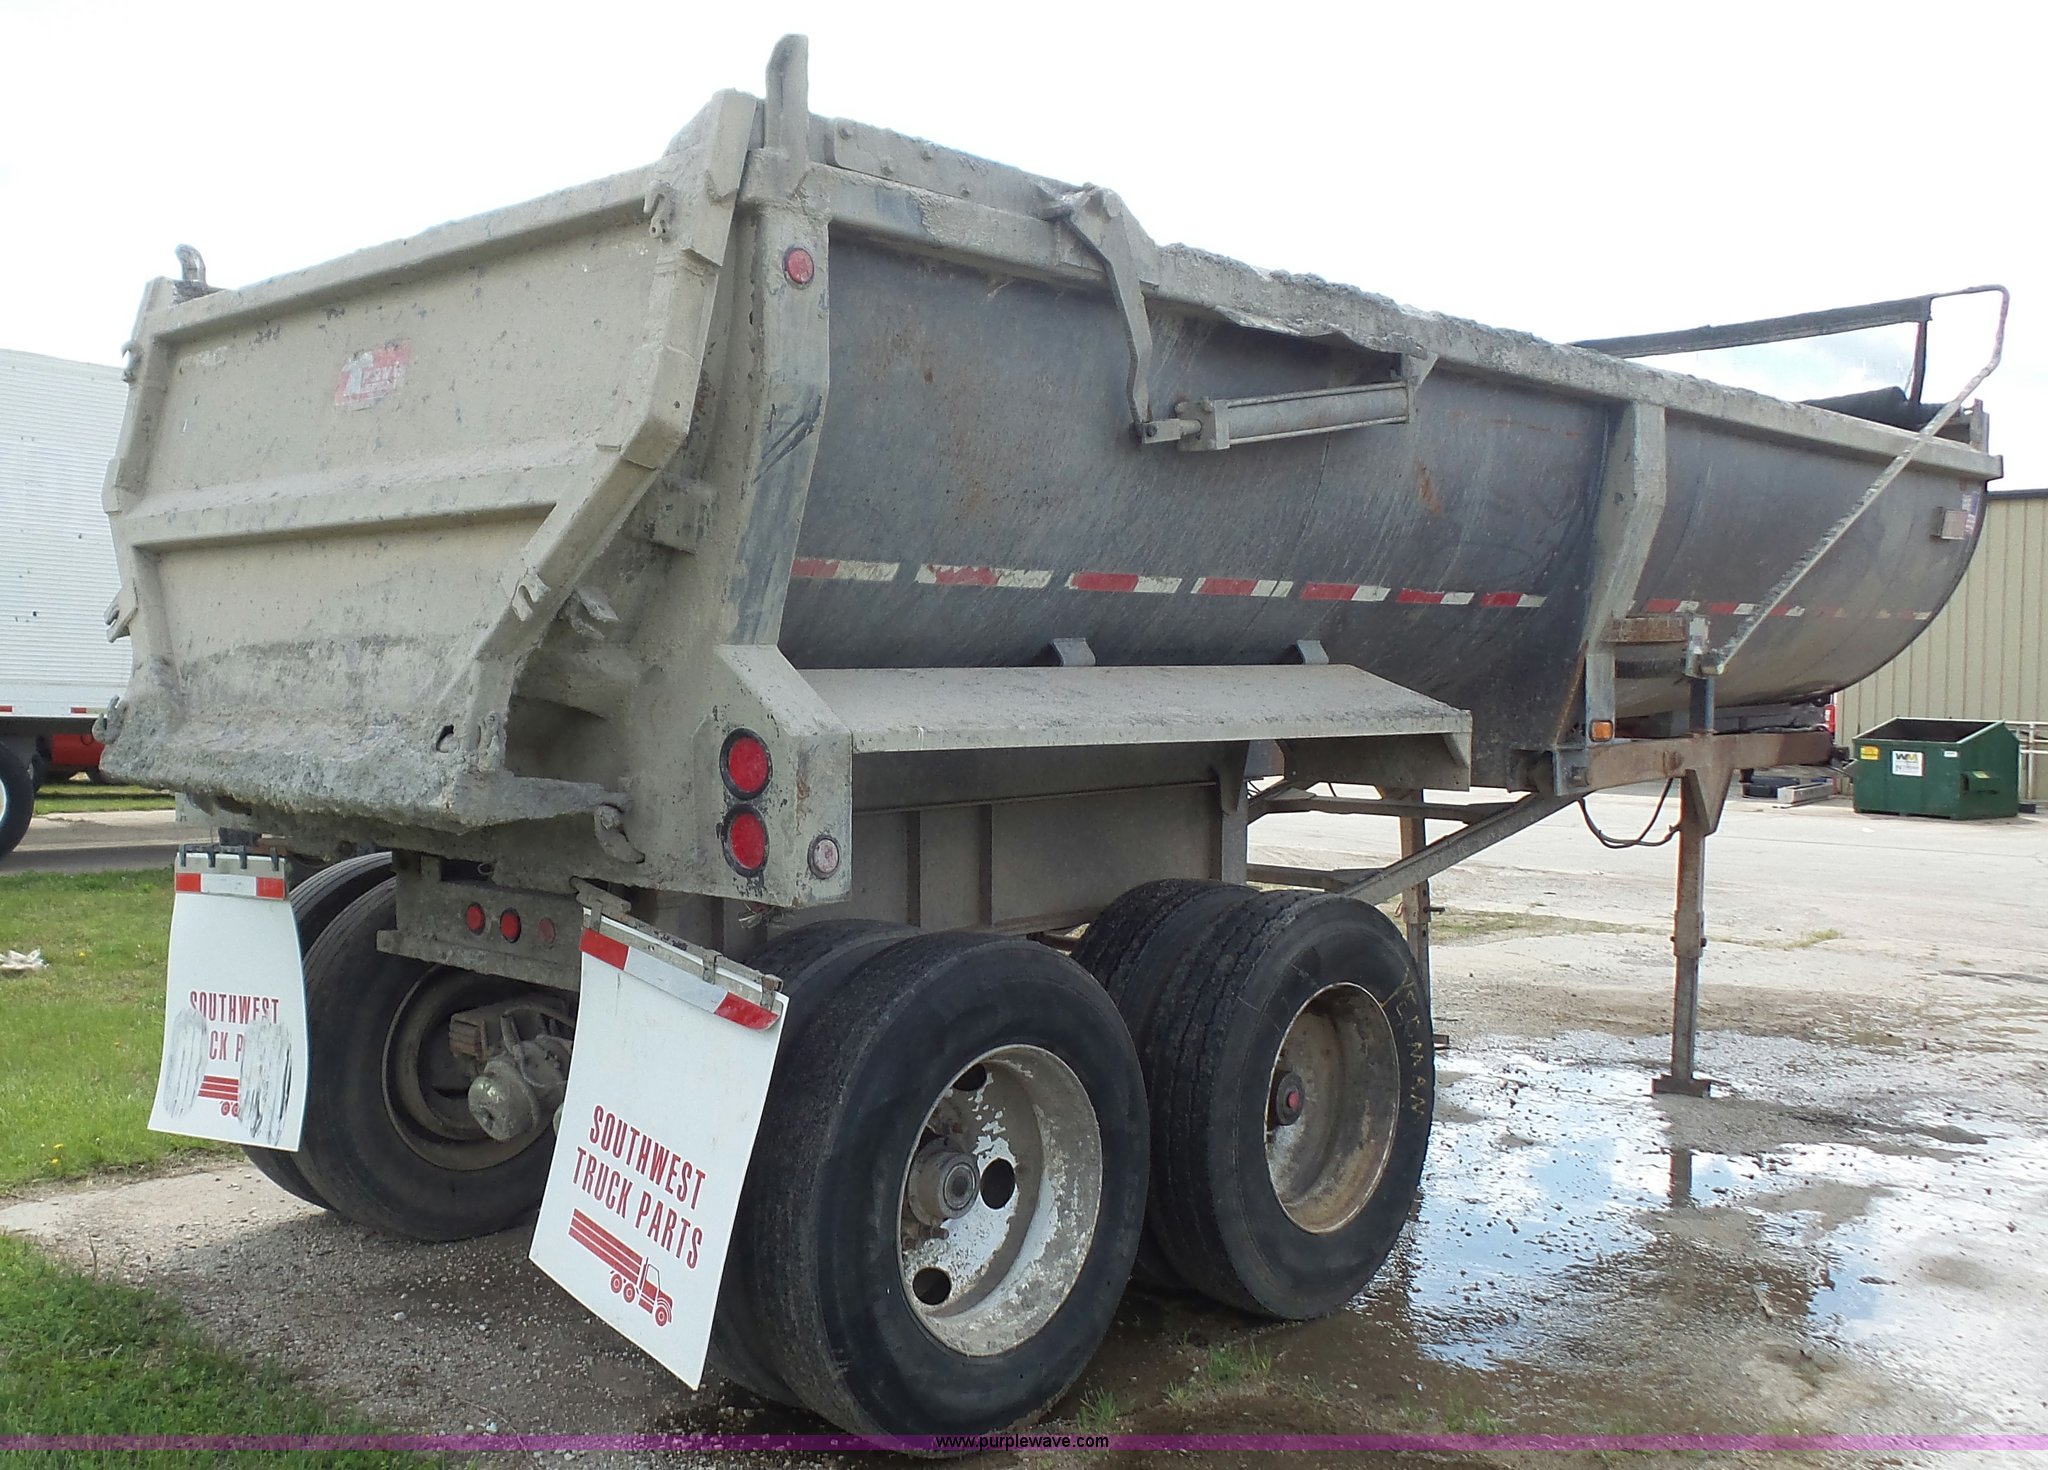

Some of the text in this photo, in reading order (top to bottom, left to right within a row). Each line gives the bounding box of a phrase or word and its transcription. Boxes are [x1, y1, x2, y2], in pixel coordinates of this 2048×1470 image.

[1895, 752, 1918, 761] WM
[190, 990, 279, 1024] SOUTHWEST
[589, 1105, 706, 1210] SOUTHWEST
[572, 1146, 703, 1269] TRUCK PARTS
